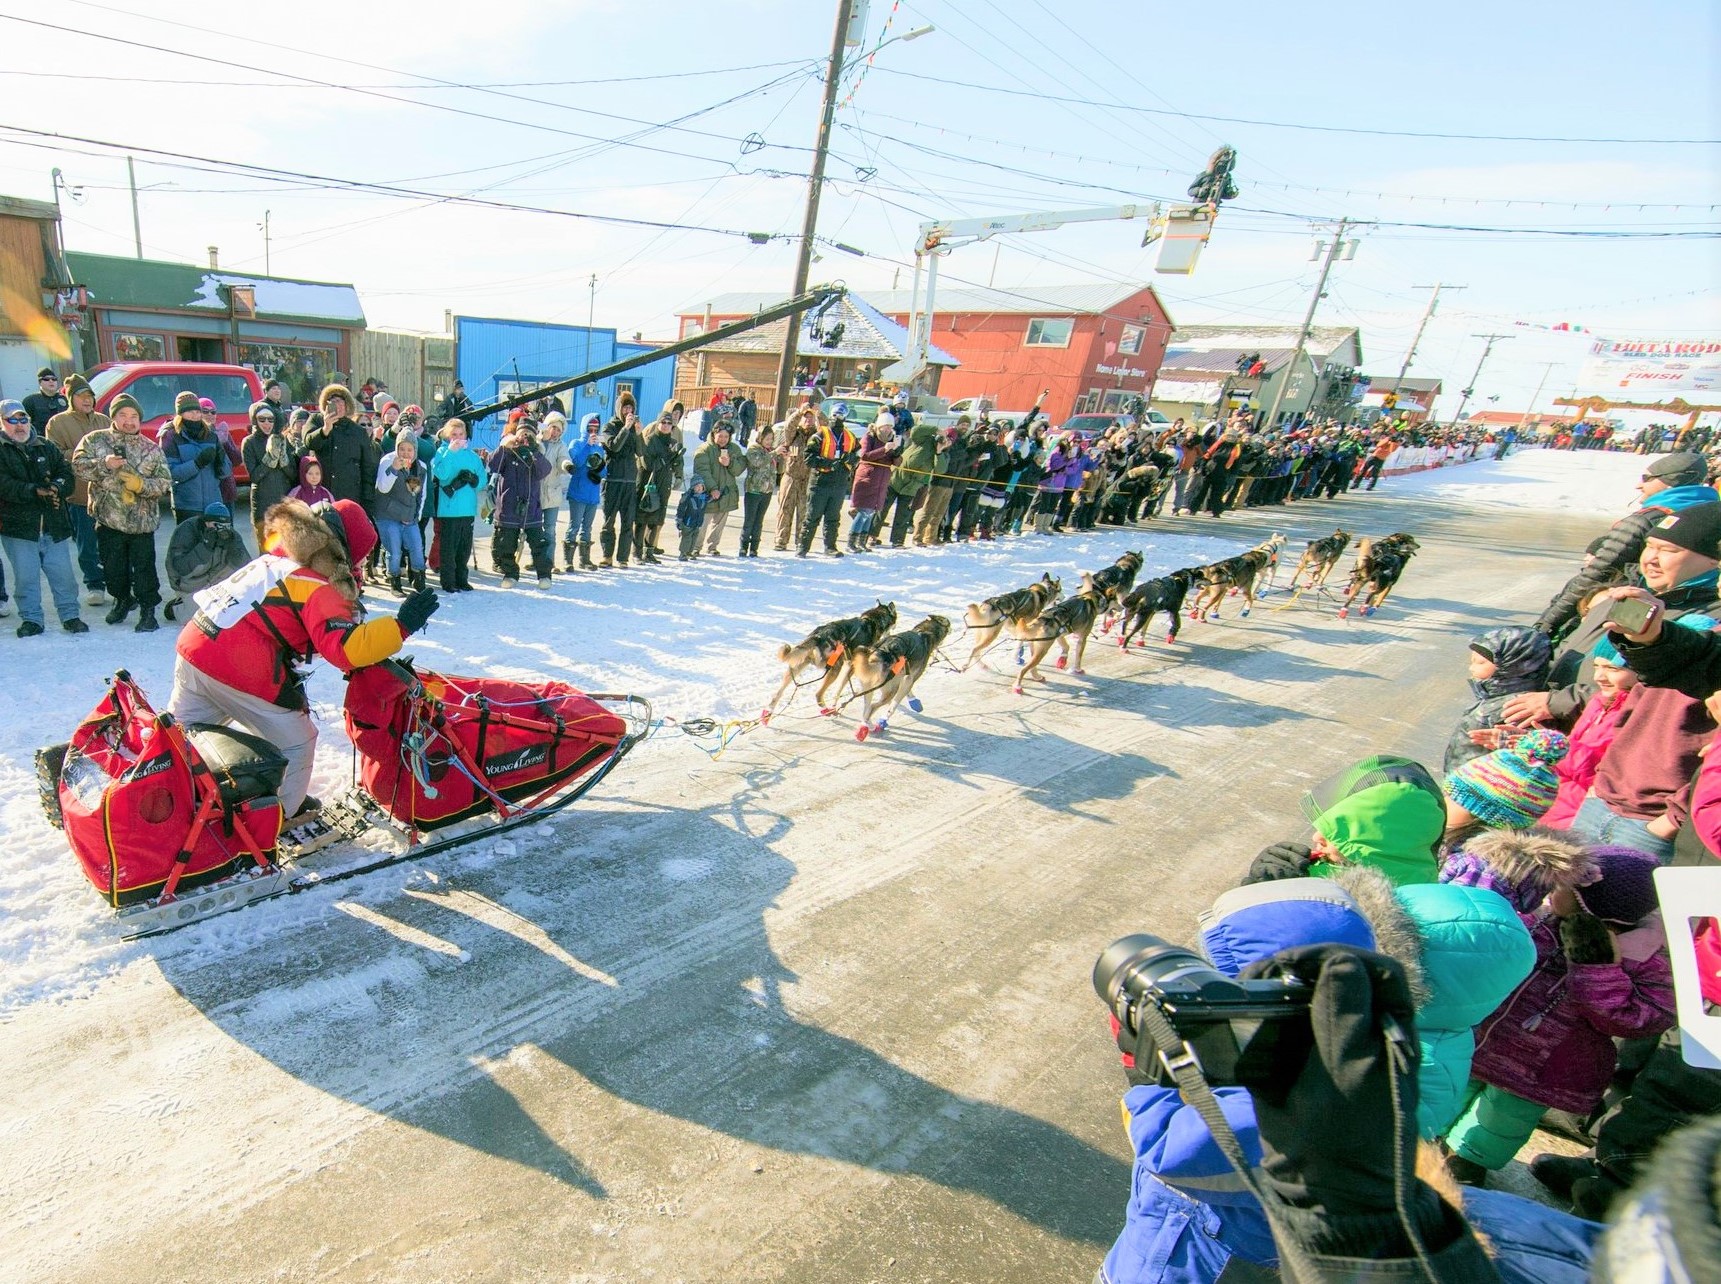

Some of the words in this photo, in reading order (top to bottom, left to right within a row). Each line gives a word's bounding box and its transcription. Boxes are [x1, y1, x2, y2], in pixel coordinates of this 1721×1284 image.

[147, 760, 172, 774] LIVING
[486, 763, 514, 775] YOUNG
[519, 754, 546, 768] LIVING
